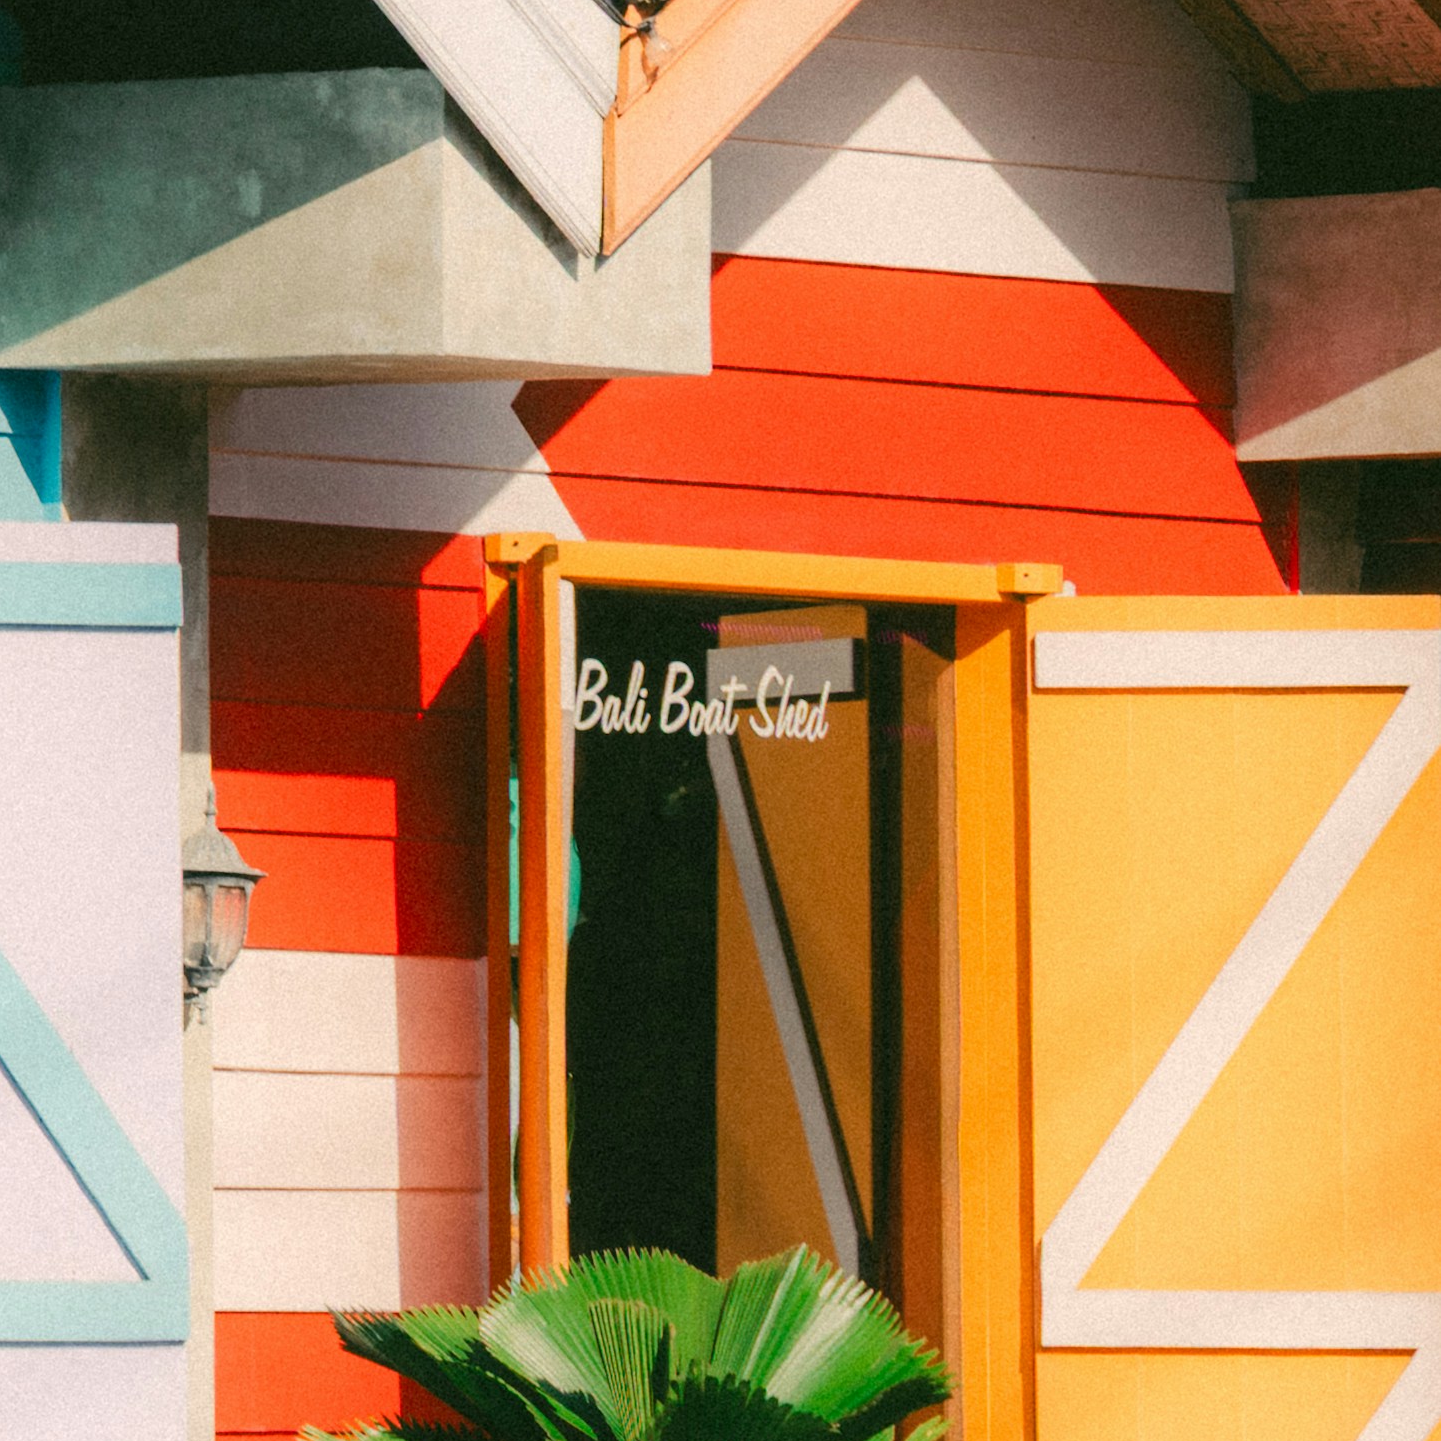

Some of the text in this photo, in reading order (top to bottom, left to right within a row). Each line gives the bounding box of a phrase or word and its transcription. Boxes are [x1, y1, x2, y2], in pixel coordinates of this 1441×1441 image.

[574, 658, 831, 742] Bali Boat Shed
